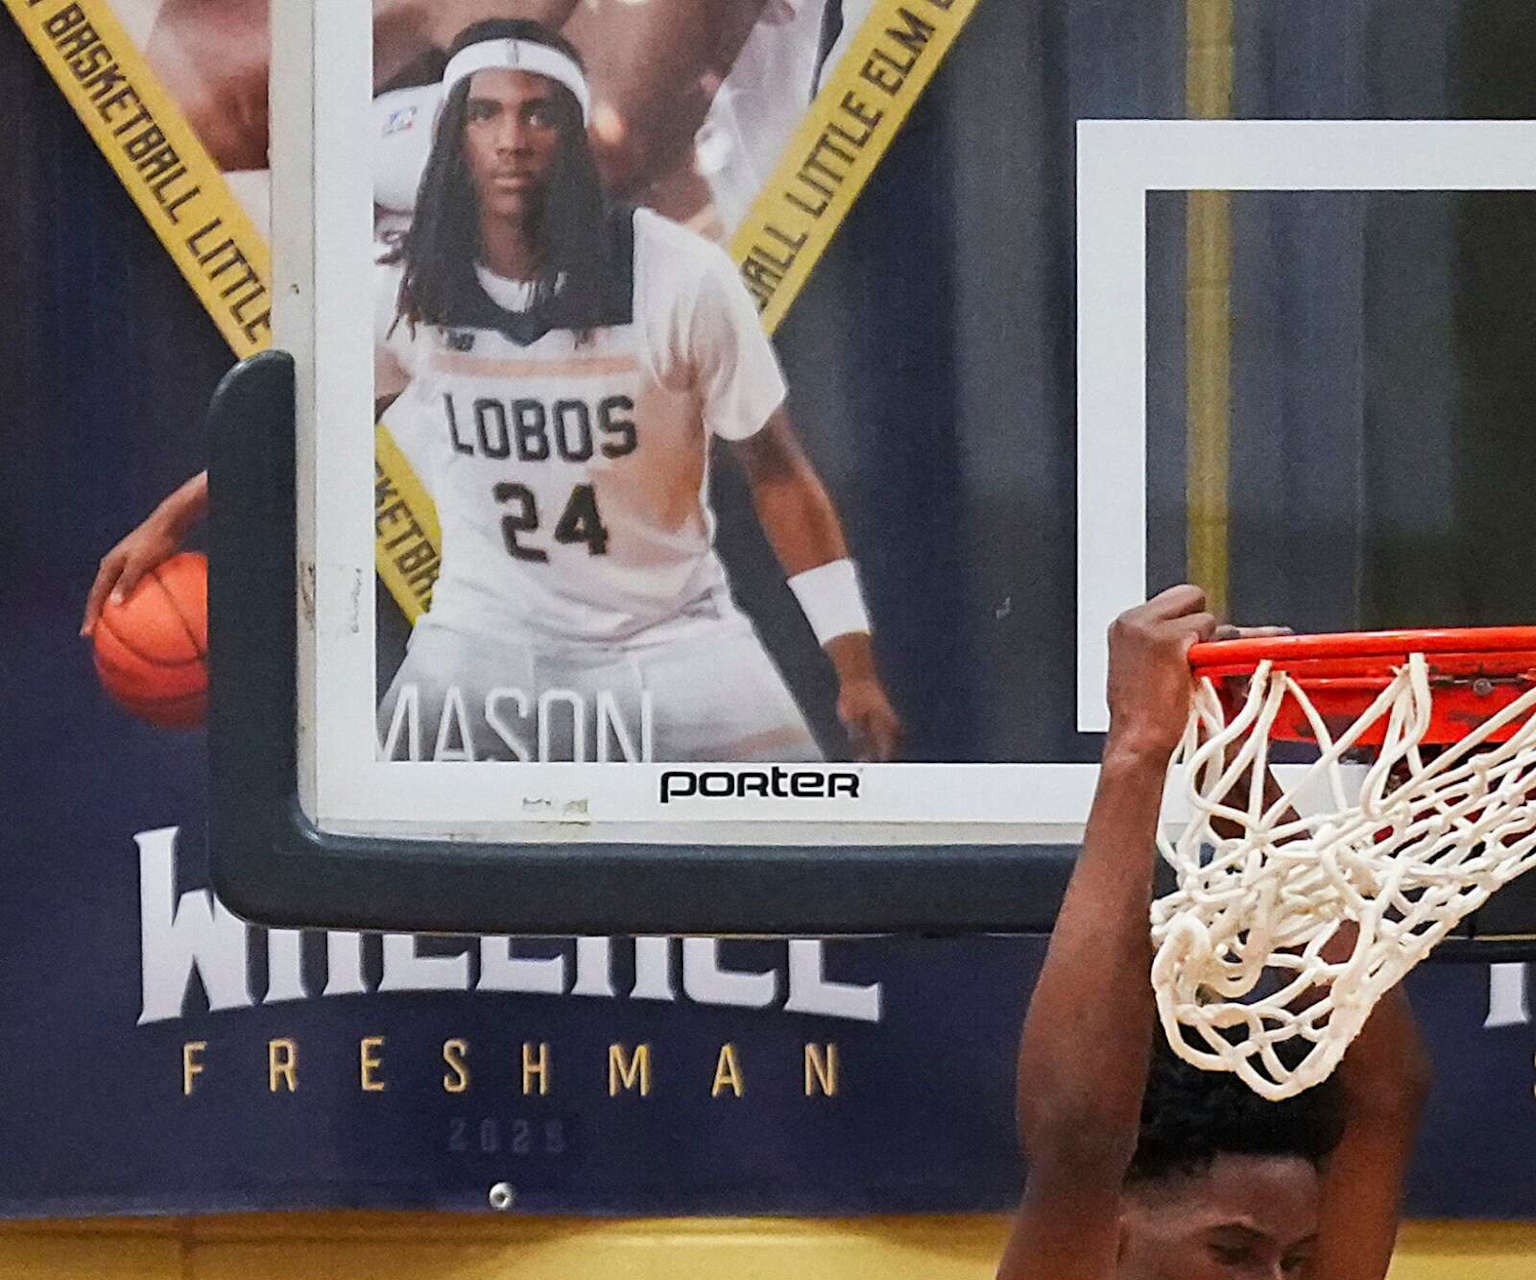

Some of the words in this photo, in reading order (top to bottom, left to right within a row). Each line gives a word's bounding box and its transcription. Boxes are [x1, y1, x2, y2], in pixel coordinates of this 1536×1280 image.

[42, 2, 200, 225] BASKETBALL
[786, 91, 884, 219] LITTLE
[859, 7, 936, 96] ELM
[443, 394, 637, 461] LOBOS
[491, 481, 608, 563] 24
[182, 1038, 842, 1097] FRESHMAN
